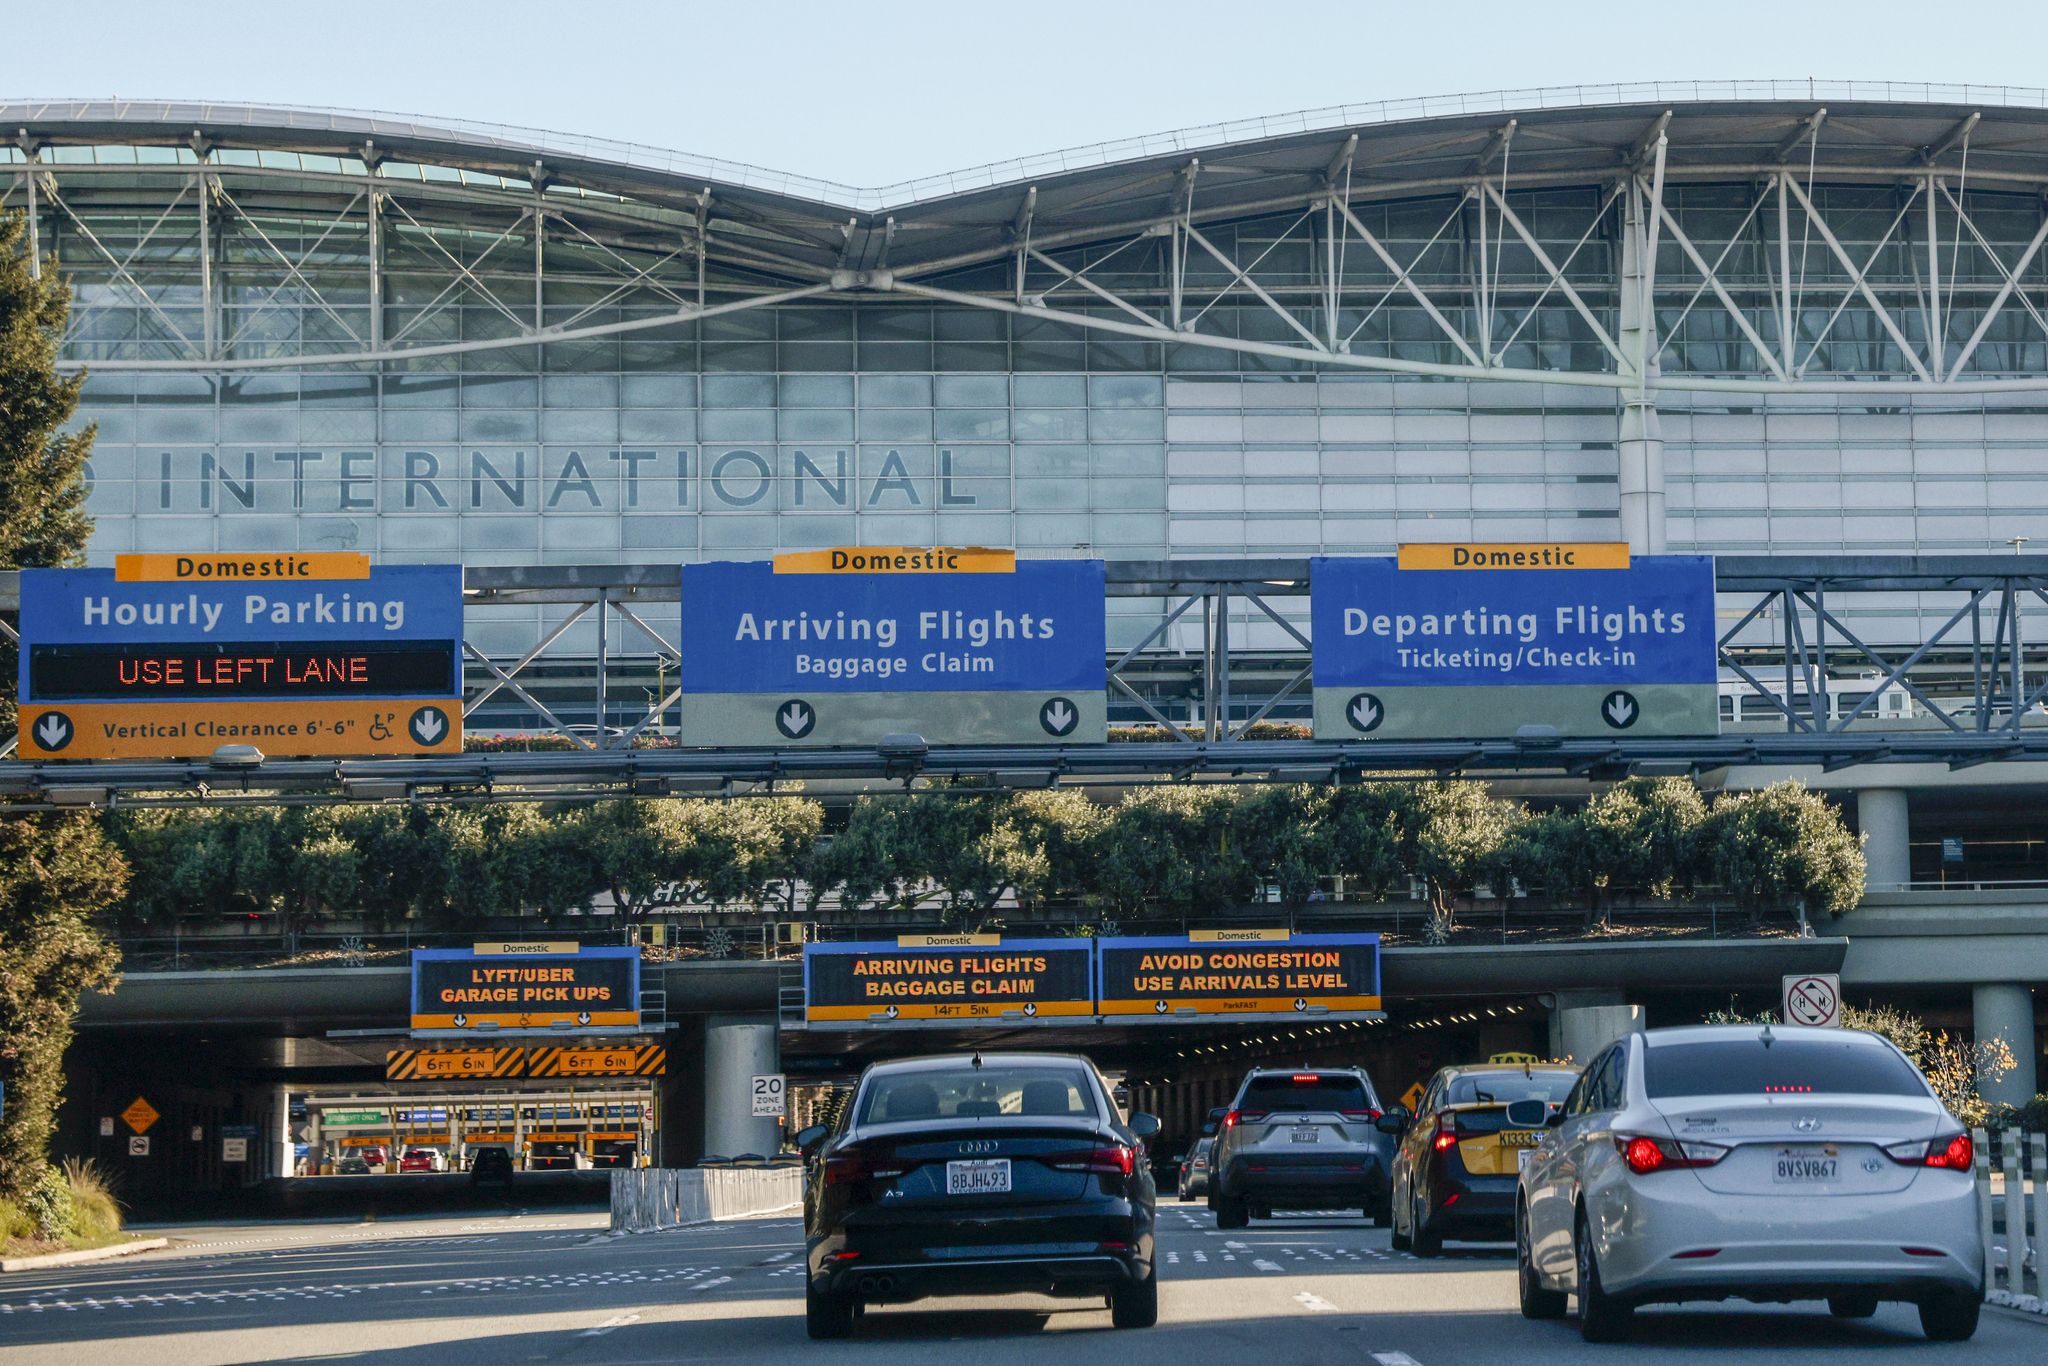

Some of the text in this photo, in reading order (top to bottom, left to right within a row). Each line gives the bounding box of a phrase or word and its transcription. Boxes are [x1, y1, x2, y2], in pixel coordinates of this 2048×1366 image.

[158, 449, 978, 509] INTERNATIONAL
[831, 549, 959, 570] Domestic
[1453, 547, 1575, 566] Domestic
[176, 556, 309, 578] Domestic
[83, 592, 405, 632] Hourly Parking
[735, 609, 1055, 648] Arriving Flights
[1343, 604, 1687, 643] Departing Flights
[796, 652, 994, 678] Baggage Claim
[1397, 646, 1636, 672] Ticketing/Check-in
[119, 656, 369, 685] USE LEFT LANE
[103, 720, 355, 738] Vertical Clearance 6'-6"
[926, 935, 972, 946] Domestic
[1217, 930, 1262, 941] Domestic
[503, 943, 550, 953] Domestic
[853, 957, 1047, 976] ARRIVING FLIGHTS
[1140, 952, 1340, 971] AVOID CONGESTION
[472, 967, 575, 983] LYFT/UBER
[1133, 973, 1348, 992] USE ARRIVALS LEVEL
[440, 986, 611, 1003] GARAGE PICK UPS
[866, 978, 1035, 997] BAGGAGE CLAIM
[754, 1078, 782, 1095] 20
[756, 1096, 780, 1104] ZONE
[1777, 1160, 1837, 1177] 8VSV867
[952, 1171, 1007, 1189] 8BJH493
